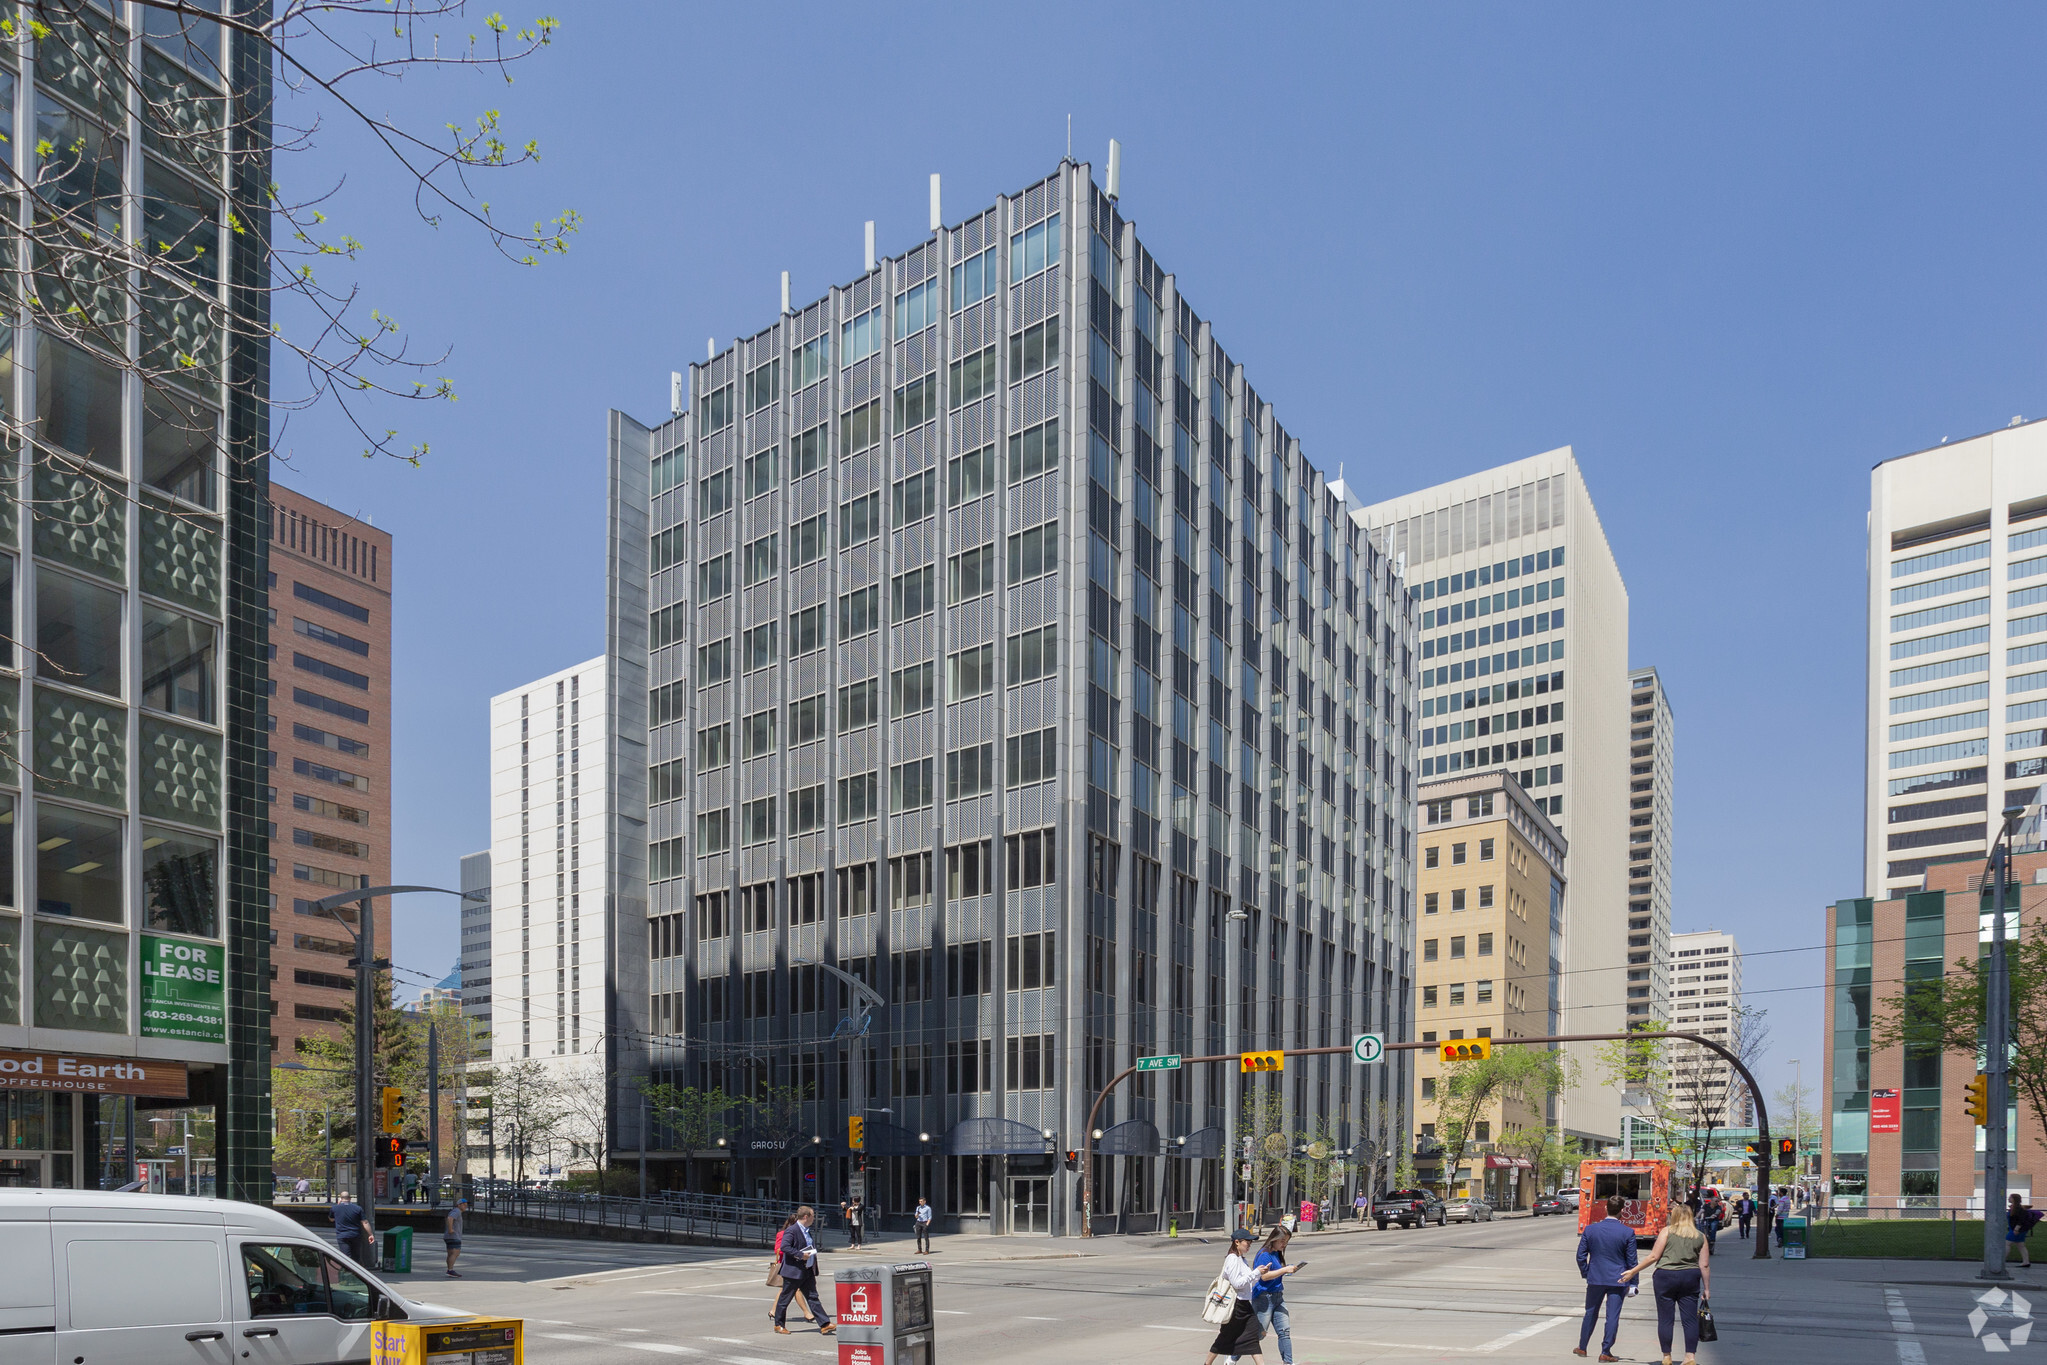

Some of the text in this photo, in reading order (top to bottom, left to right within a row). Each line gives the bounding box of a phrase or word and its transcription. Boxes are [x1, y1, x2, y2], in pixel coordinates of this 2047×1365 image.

[159, 943, 207, 964] FOR
[144, 961, 220, 984] LEASE
[174, 1001, 211, 1010] INVESTMENTS
[144, 1010, 223, 1025] 403-269-4381
[142, 1026, 224, 1039] www.estancia.ca
[57, 1057, 146, 1081] Earth
[1139, 1057, 1178, 1068] 7 AVE SW
[751, 1141, 785, 1150] GAROSU
[841, 1314, 877, 1322] TRANSIT
[374, 1331, 406, 1353] Start
